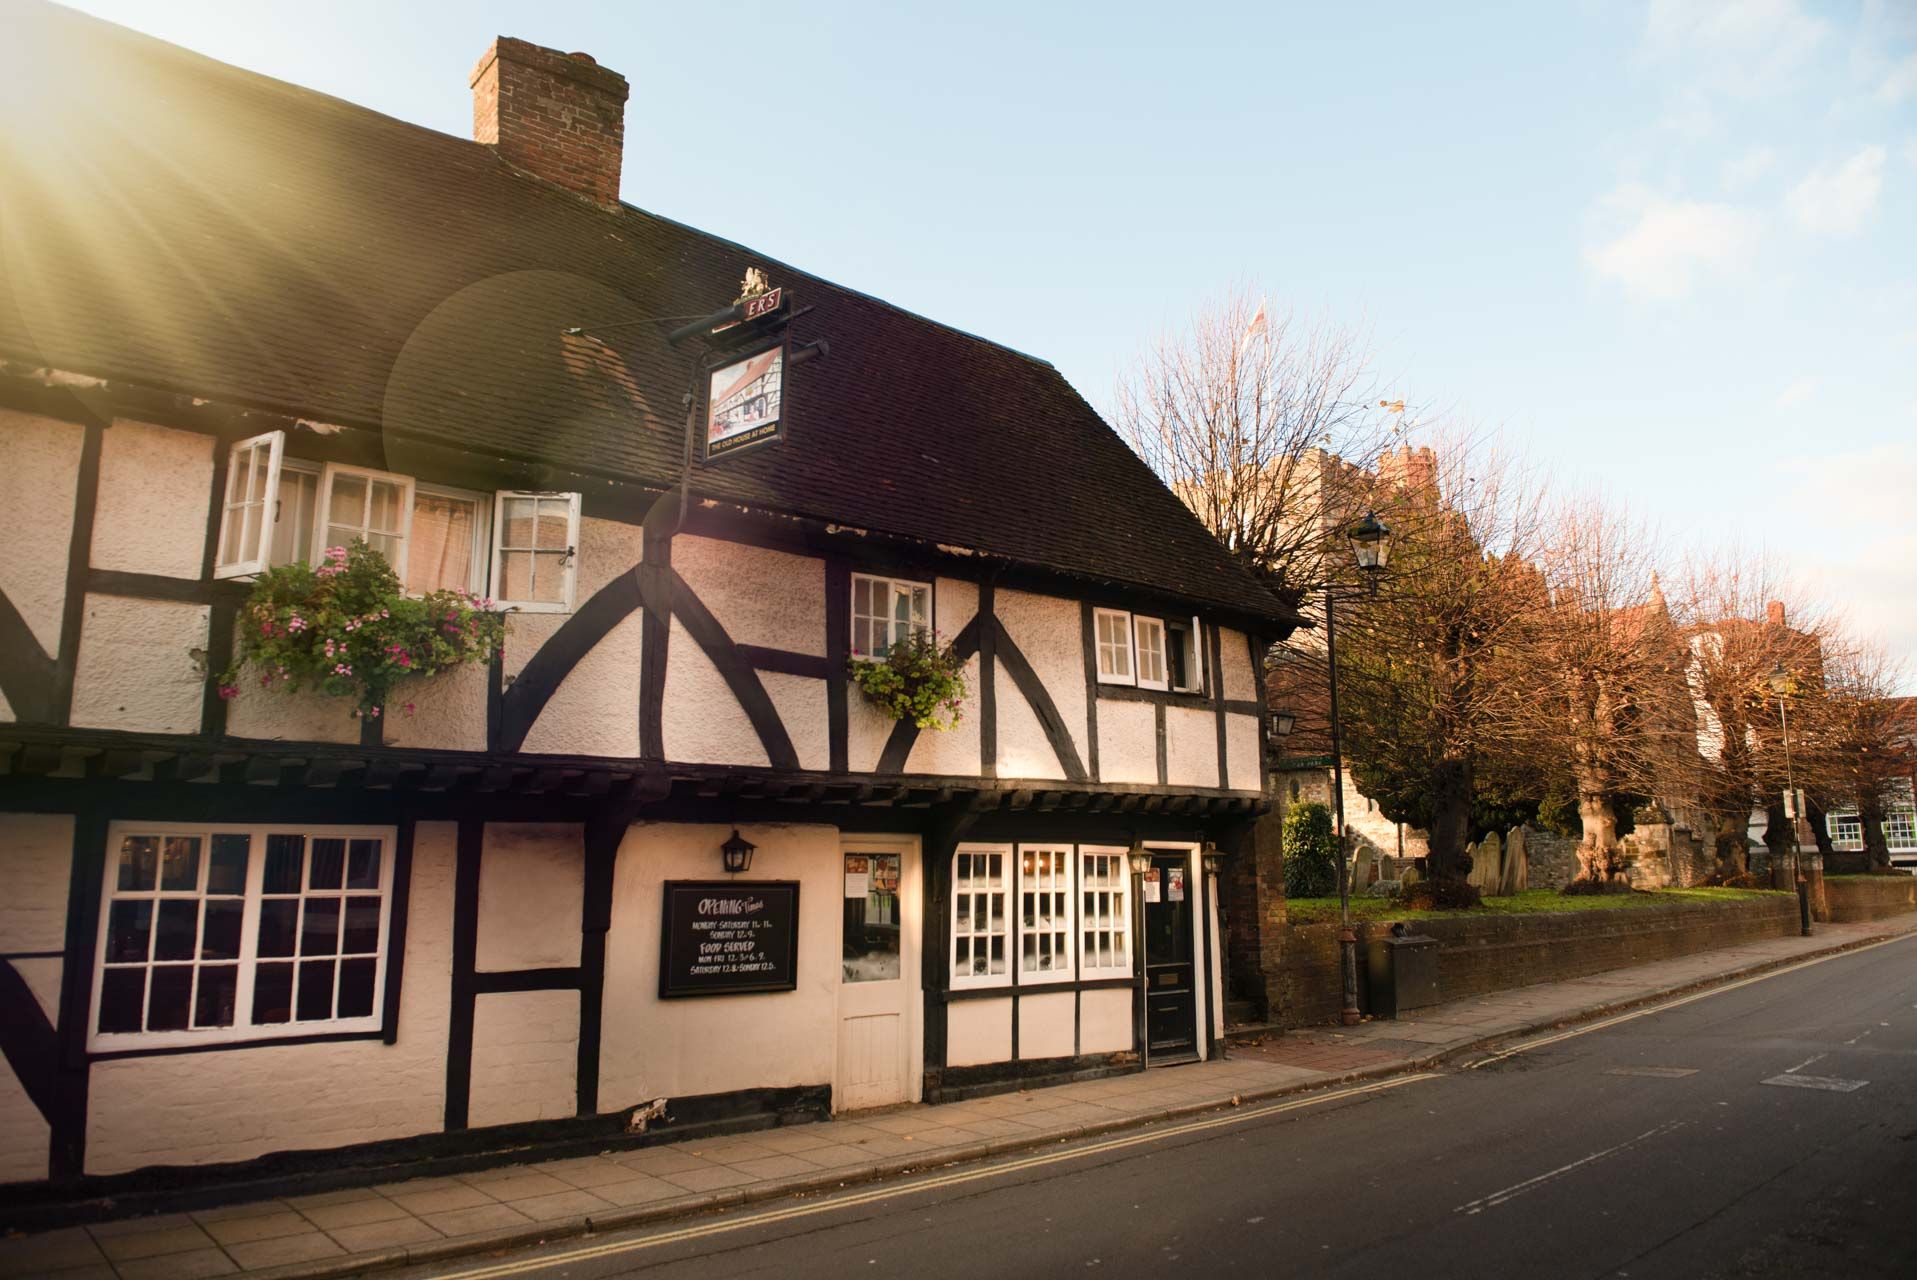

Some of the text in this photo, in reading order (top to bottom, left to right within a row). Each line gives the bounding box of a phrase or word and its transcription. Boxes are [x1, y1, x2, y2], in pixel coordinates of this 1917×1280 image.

[721, 439, 733, 447] OLD
[733, 432, 751, 445] HOUSE
[751, 429, 759, 439] AT
[759, 423, 776, 435] HOME
[698, 898, 742, 915] OPENING
[709, 930, 735, 939] SUNDAY
[700, 941, 755, 955] FOOD SERVED
[690, 965, 721, 975] SATURDAY
[739, 963, 760, 972] SUNDAY
